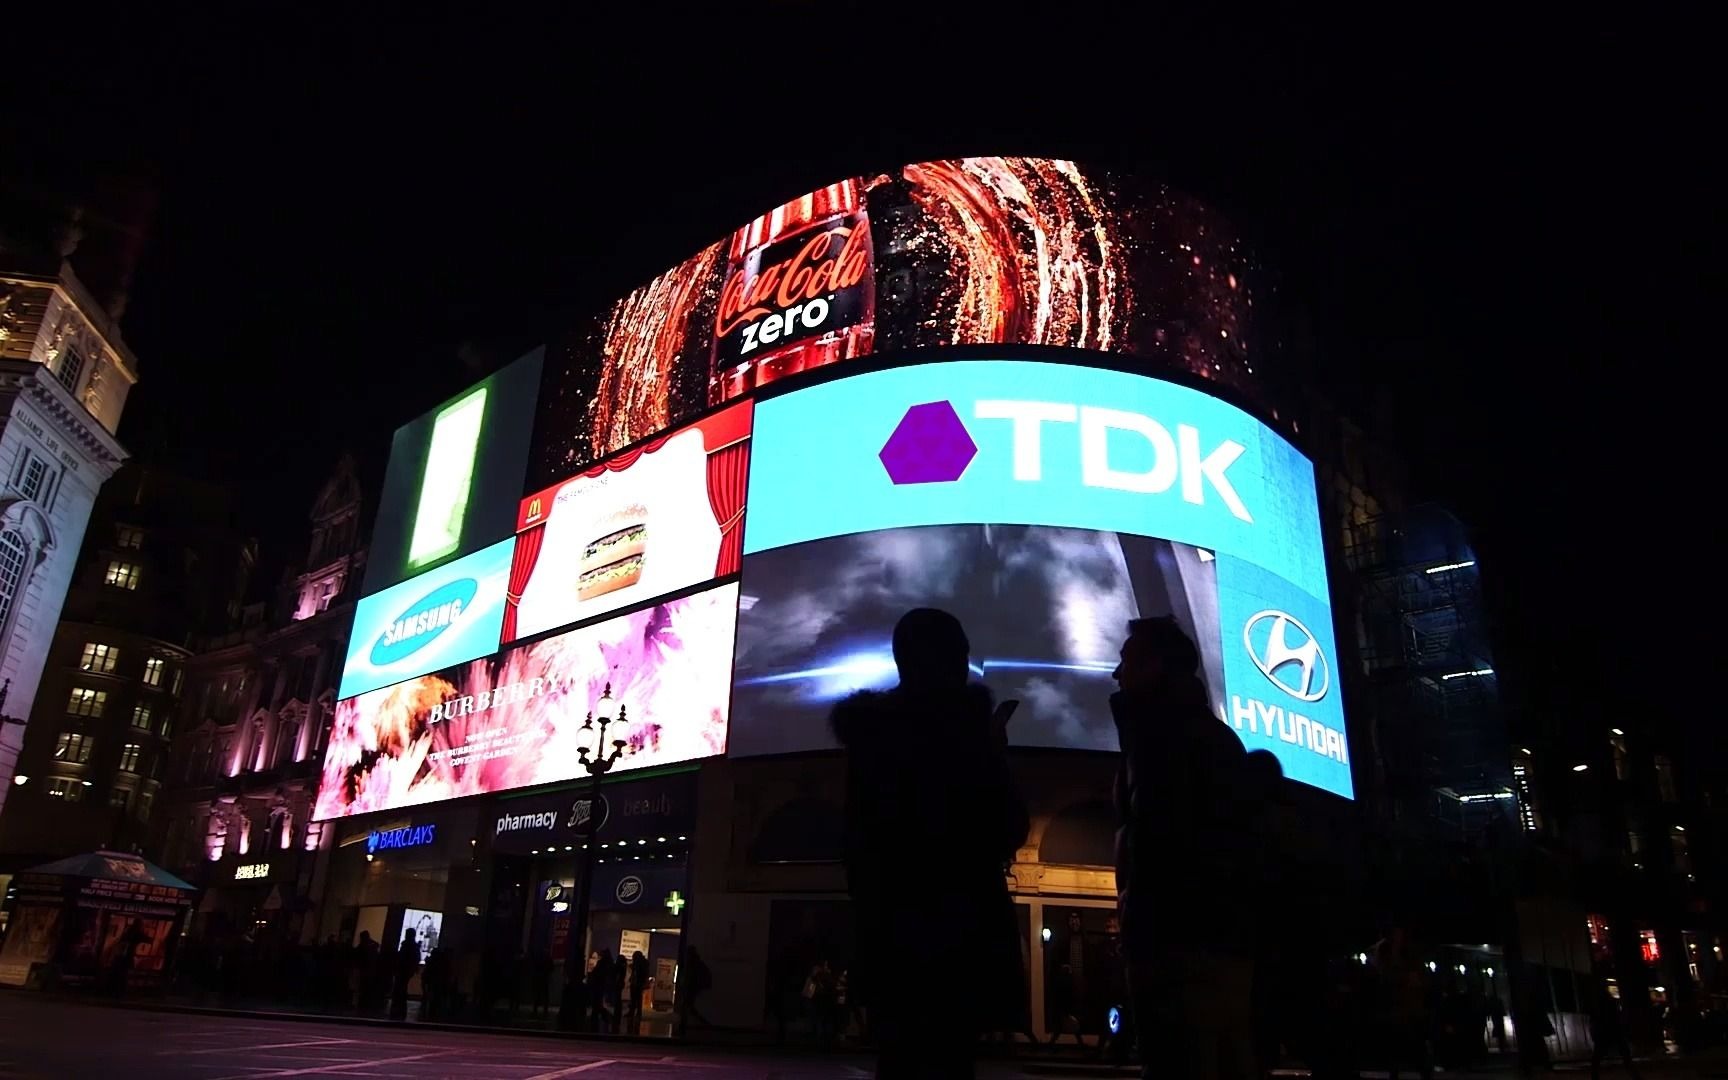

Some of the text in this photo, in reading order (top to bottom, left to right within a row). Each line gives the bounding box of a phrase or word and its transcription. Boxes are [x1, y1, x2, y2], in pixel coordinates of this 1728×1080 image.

[716, 220, 868, 338] Coca-Cola
[740, 297, 829, 355] zero
[974, 399, 1254, 524] TDK
[383, 598, 463, 647] SAMSUNG
[428, 672, 562, 724] BURBERRY
[1232, 695, 1348, 765] HYUNDAI
[379, 823, 437, 849] BARCLAYS
[496, 810, 558, 836] pharmacy
